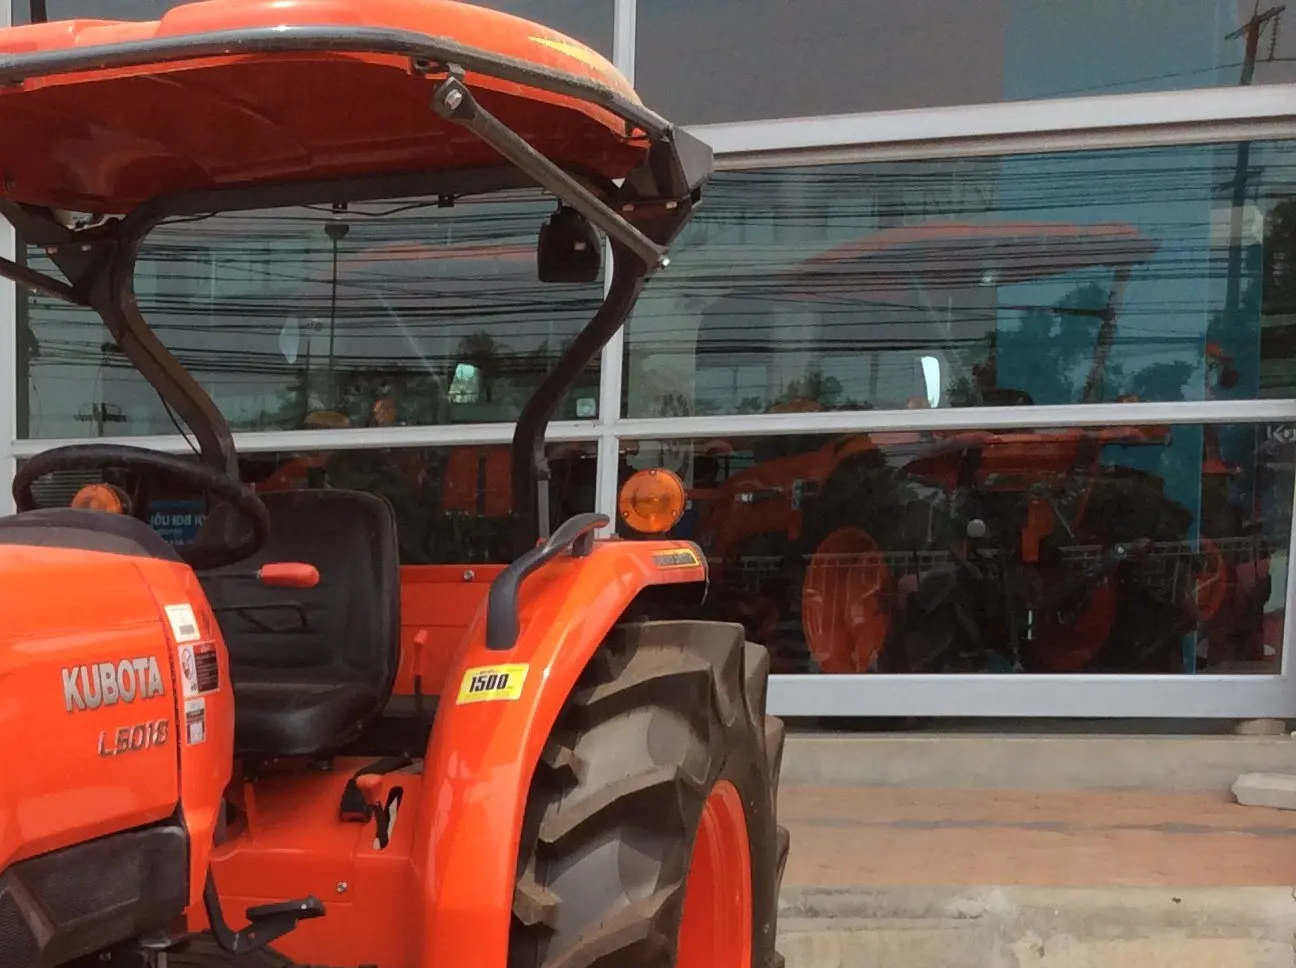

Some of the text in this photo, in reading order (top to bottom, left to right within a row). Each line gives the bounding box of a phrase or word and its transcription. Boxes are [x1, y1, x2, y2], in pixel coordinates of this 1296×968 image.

[61, 656, 165, 712] KUBOTA
[469, 673, 509, 693] 1500
[98, 718, 169, 757] L5018
